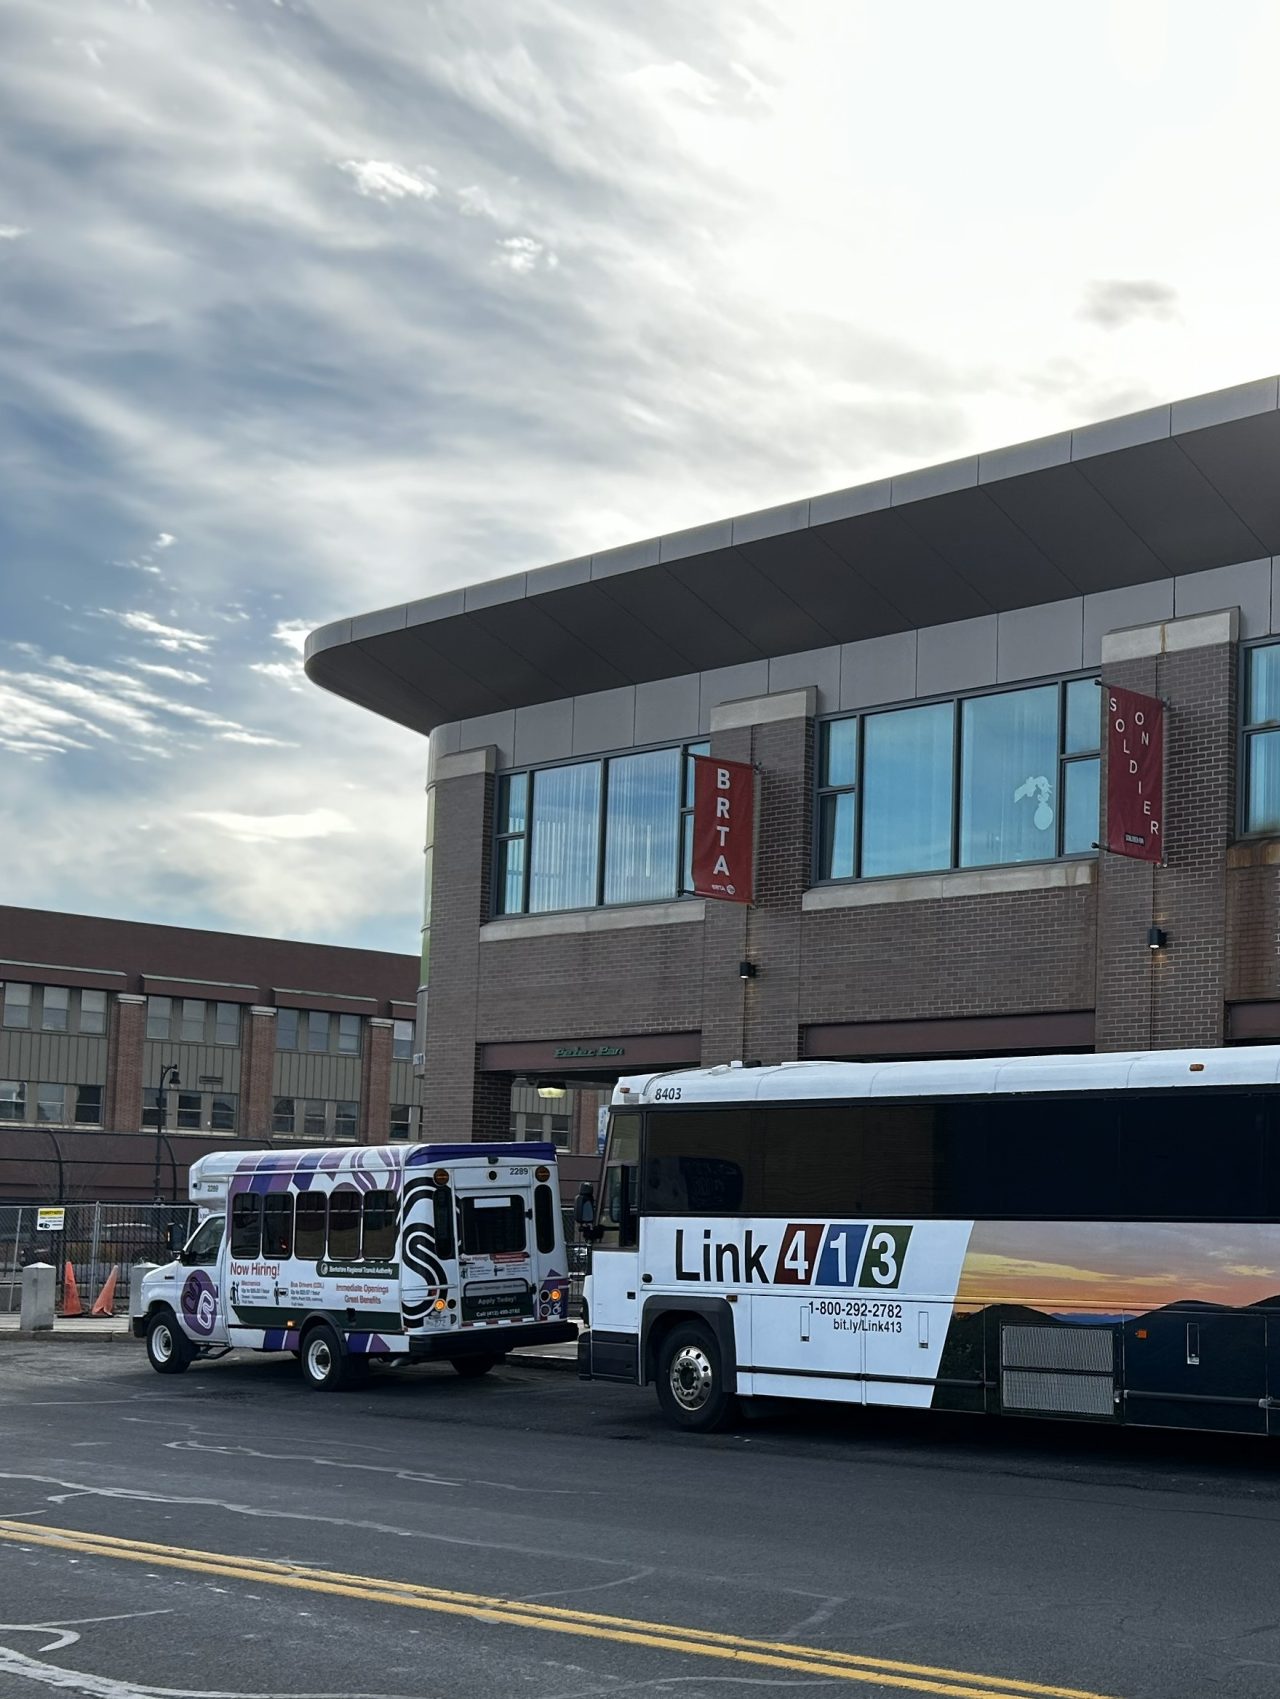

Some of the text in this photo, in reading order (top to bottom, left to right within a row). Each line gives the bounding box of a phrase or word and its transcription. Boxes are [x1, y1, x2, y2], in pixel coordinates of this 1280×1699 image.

[1134, 711, 1150, 747] ON
[1109, 697, 1160, 836] SOLDIER
[712, 767, 731, 877] BRTA
[655, 1087, 682, 1101] 8403
[510, 1167, 528, 1176] 2289
[230, 1262, 280, 1280] Now Hiring!
[347, 1266, 362, 1274] Regional
[375, 1267, 393, 1275] Authority
[336, 1283, 389, 1295] Immediate Openings
[344, 1295, 382, 1304] Great Benefits
[477, 1298, 496, 1306] Apply
[809, 1301, 903, 1319] 1-800-292-2782
[833, 1319, 902, 1333] bit.ly/Link413
